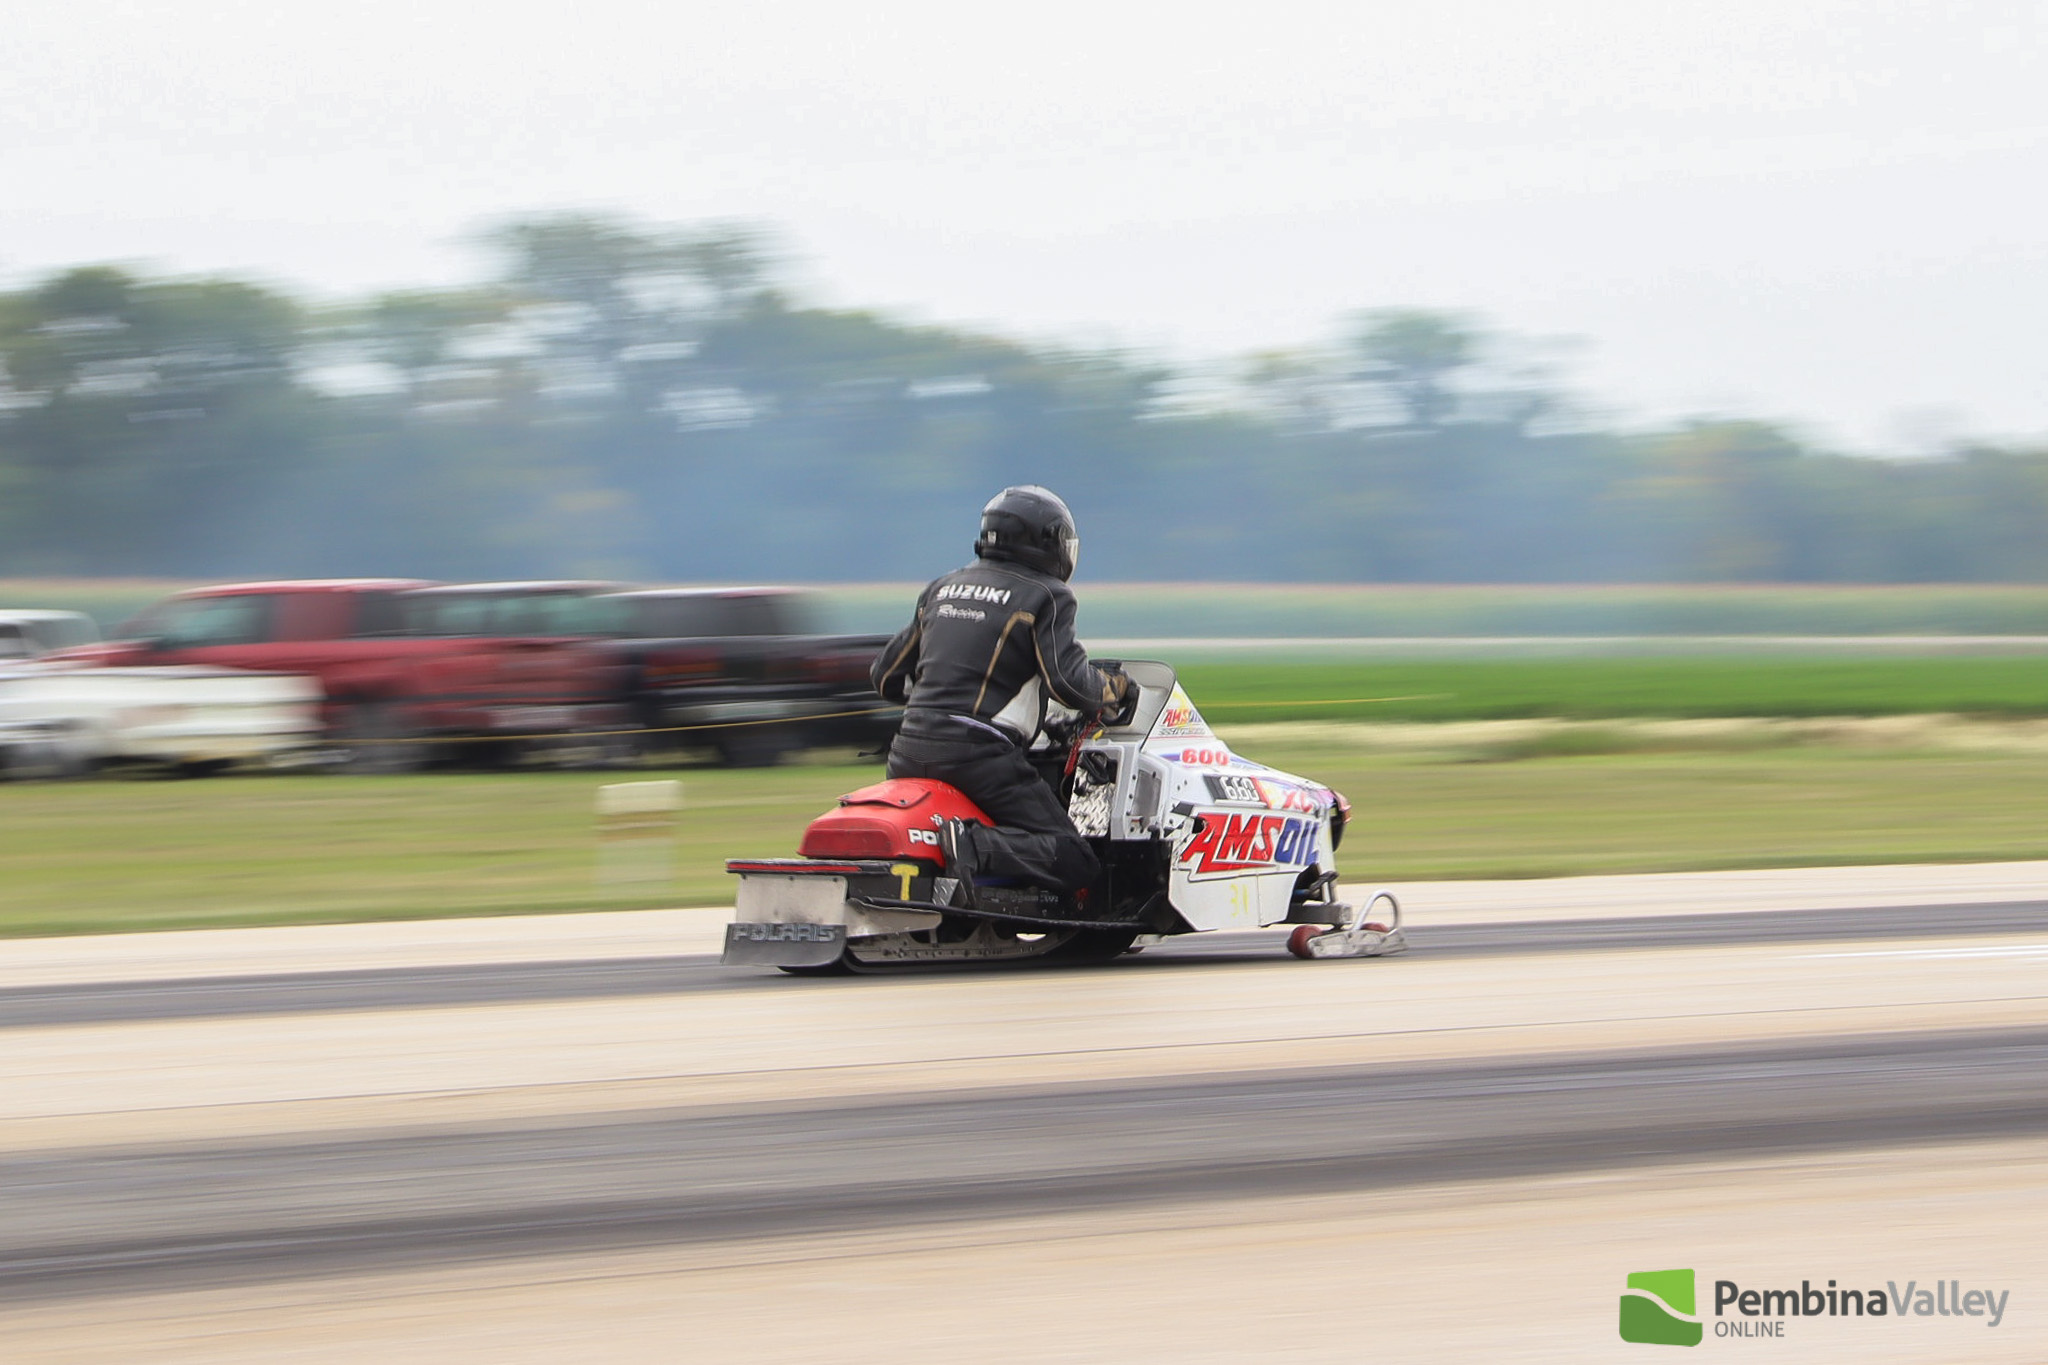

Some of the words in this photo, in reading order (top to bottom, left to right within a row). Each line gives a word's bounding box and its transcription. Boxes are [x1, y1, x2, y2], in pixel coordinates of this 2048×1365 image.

[937, 584, 1011, 605] SUZUKI
[1182, 749, 1229, 766] 600
[907, 828, 941, 846] PO
[1180, 812, 1320, 874] AMSOIL
[890, 864, 920, 901] T
[733, 923, 837, 943] POLARIS
